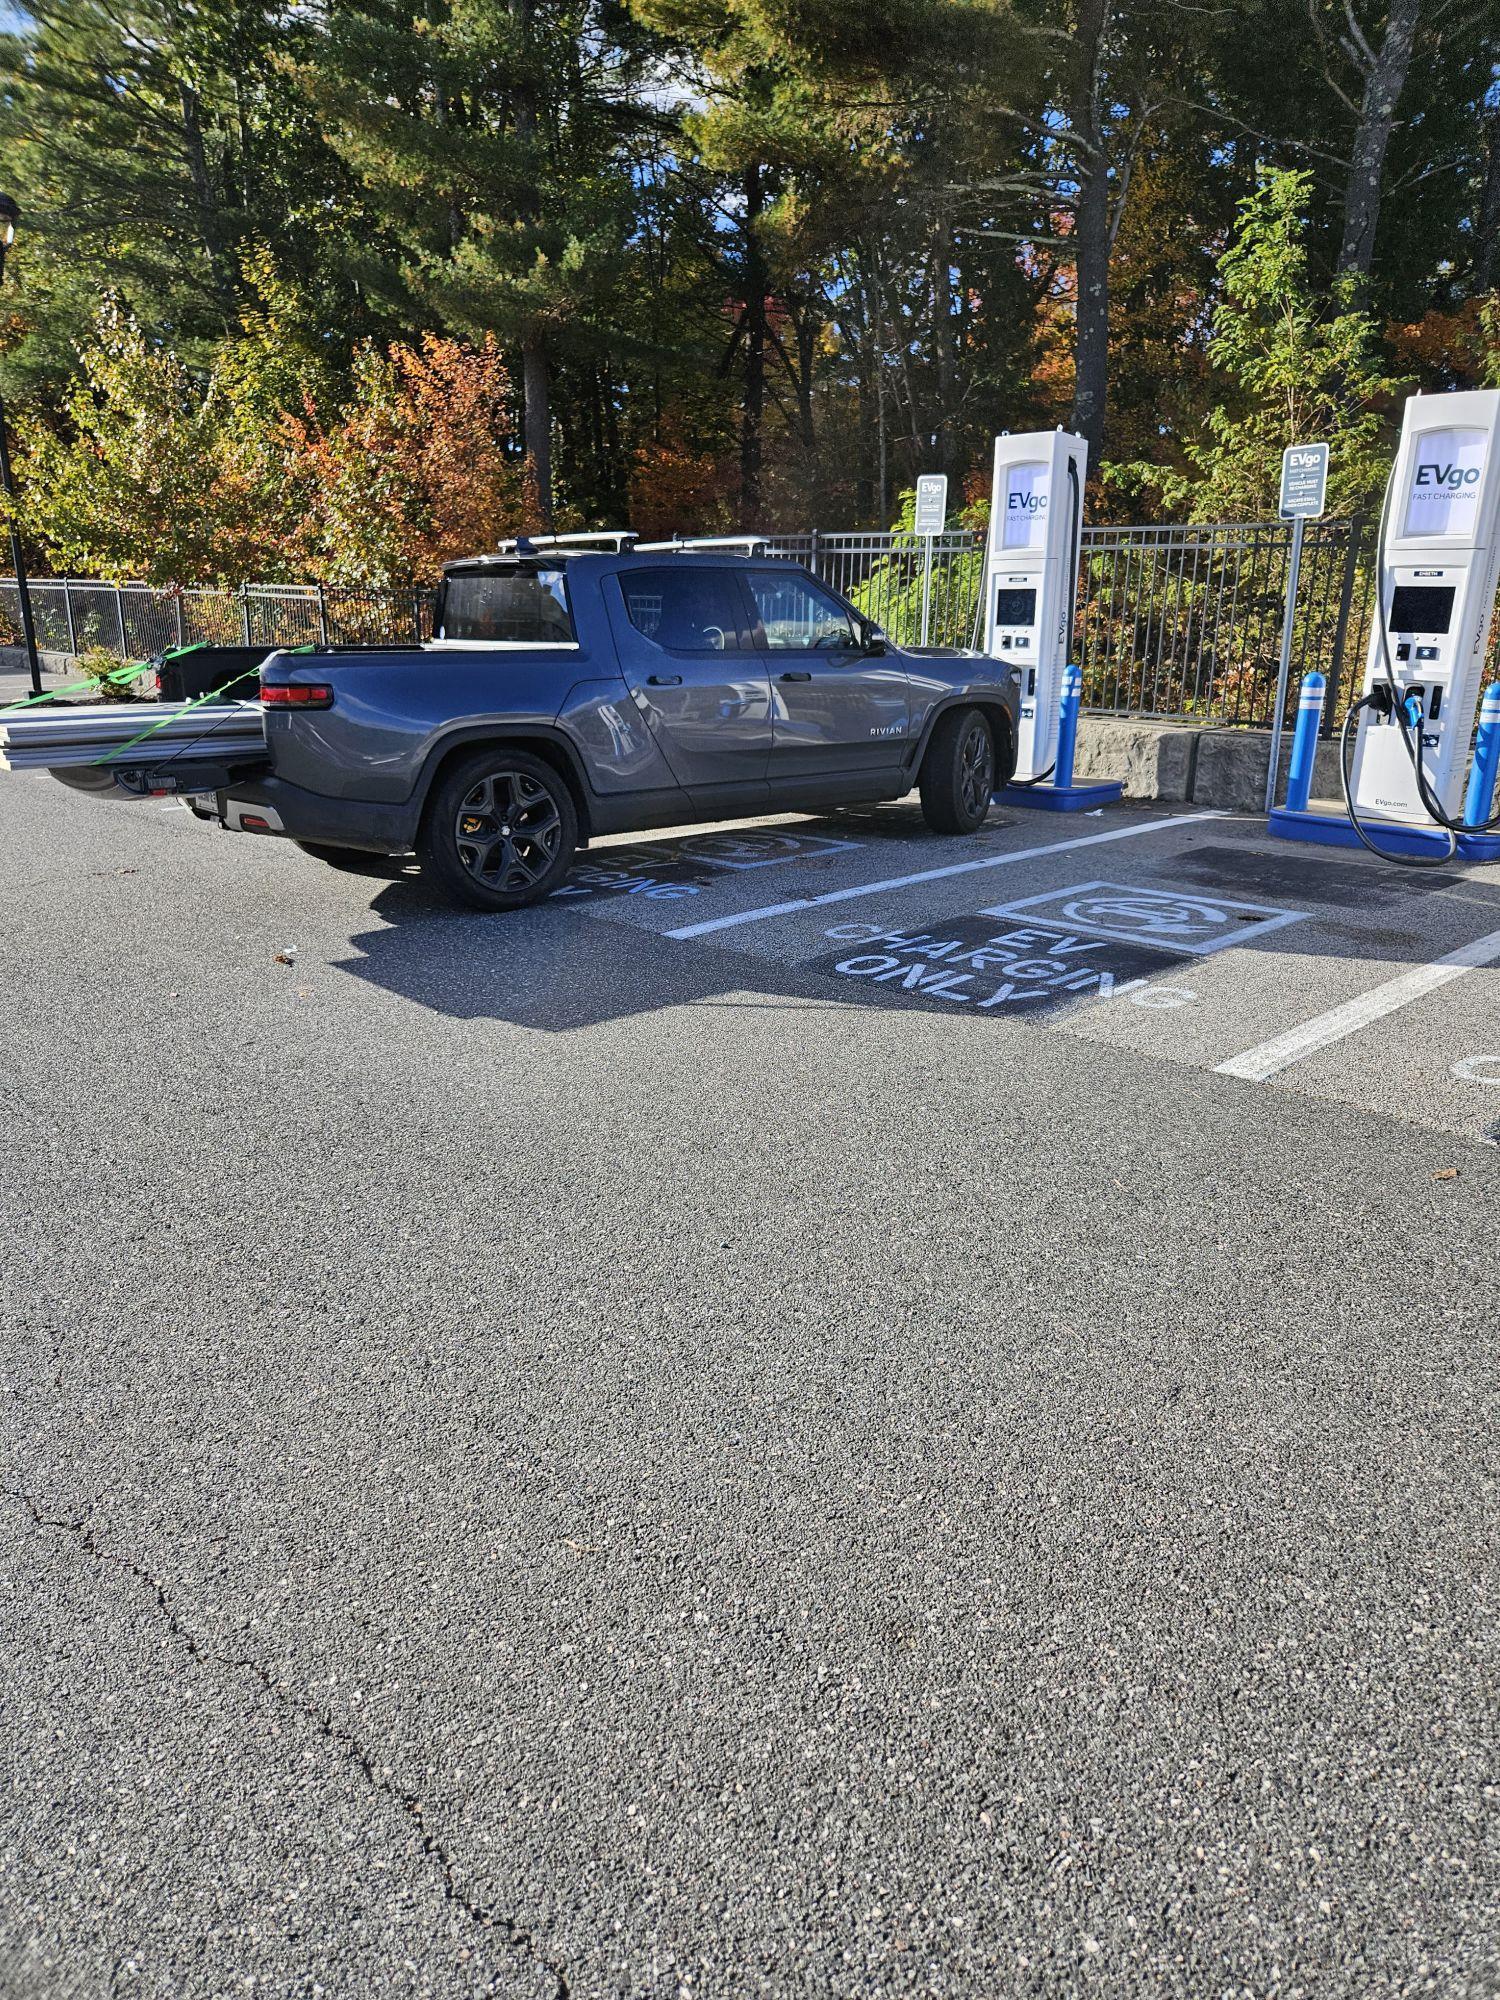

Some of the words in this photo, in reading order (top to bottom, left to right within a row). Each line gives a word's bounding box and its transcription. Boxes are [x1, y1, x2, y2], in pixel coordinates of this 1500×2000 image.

[1290, 453, 1321, 467] EVgo
[922, 482, 942, 495] EVgo
[1415, 464, 1480, 490] EVgo
[1008, 492, 1047, 513] EVgo
[1412, 493, 1432, 501] FAST
[1433, 491, 1477, 500] CHARGING
[1058, 611, 1067, 645] EVgo
[1472, 613, 1485, 655] EVgo
[870, 726, 902, 735] RIVIAN
[1375, 798, 1408, 808] EVgo.com
[988, 928, 1107, 954] EV
[824, 923, 1197, 1008] CHARGING
[835, 955, 1051, 1007] ONLY
